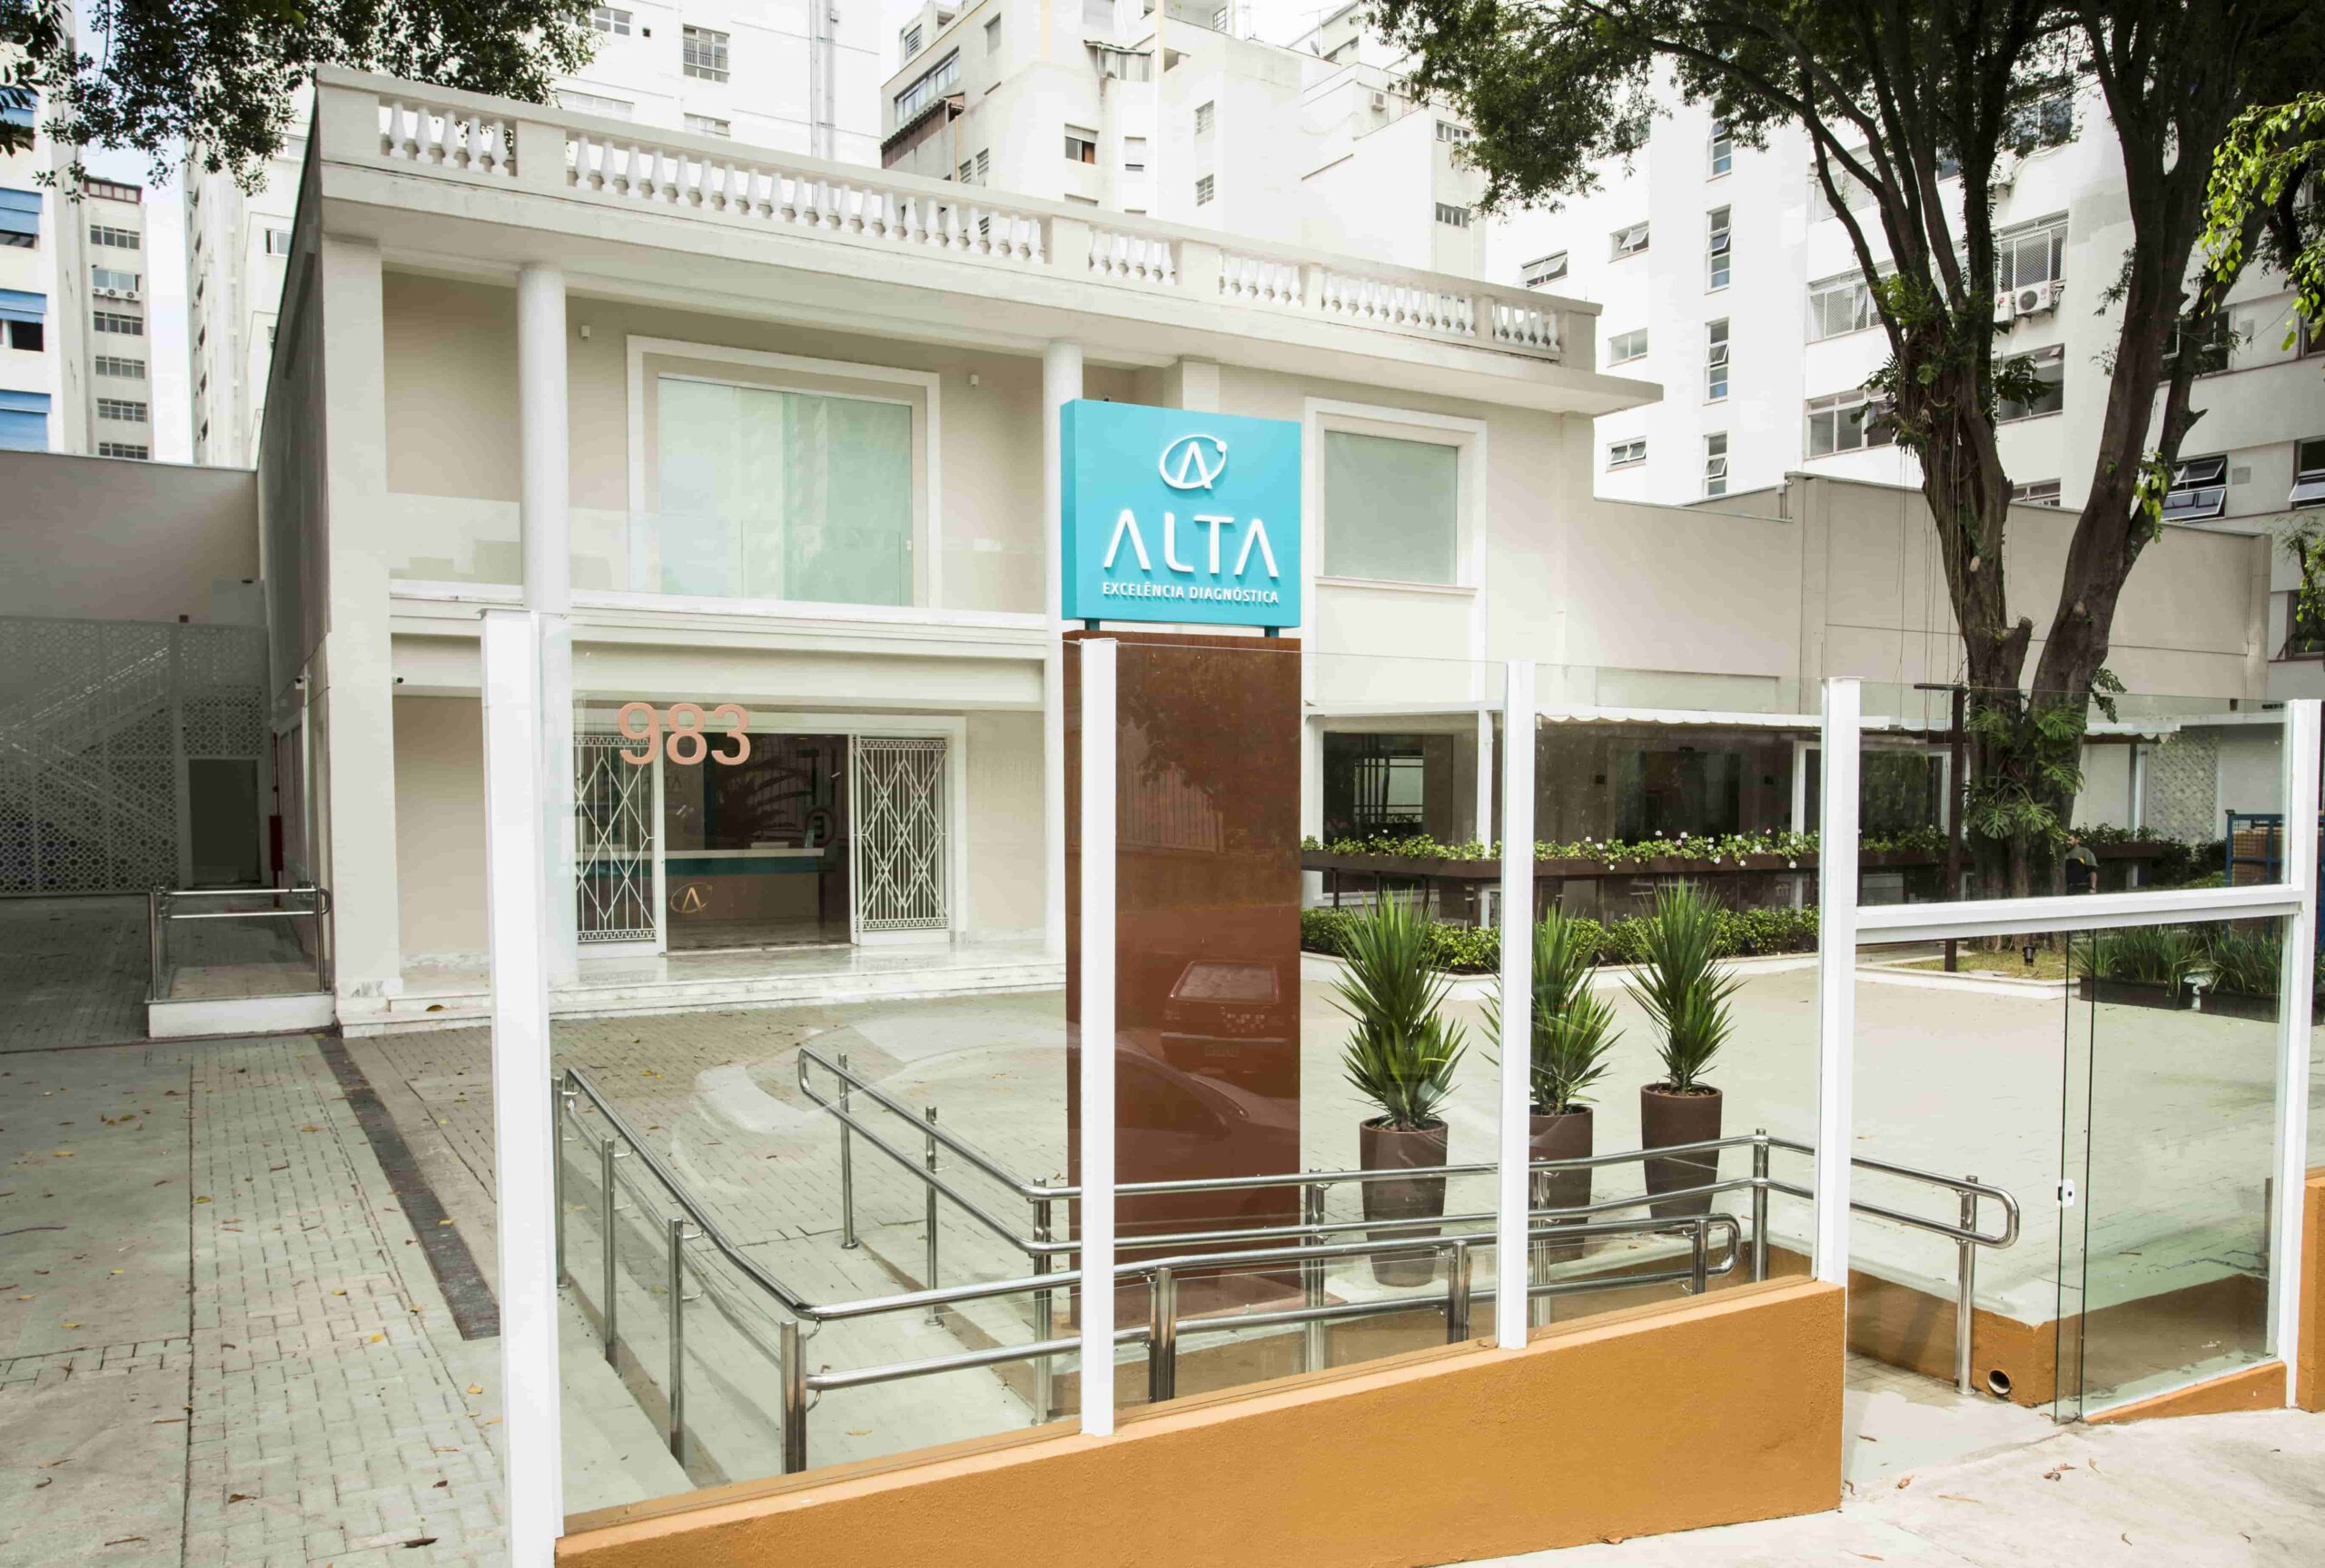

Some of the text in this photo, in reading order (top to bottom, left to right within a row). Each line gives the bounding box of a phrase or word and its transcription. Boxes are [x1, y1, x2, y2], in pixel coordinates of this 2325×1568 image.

[1103, 508, 1279, 577] ALTA
[1103, 581, 1279, 603] EXCELÊNCIA DIAGNÓSTICA
[618, 702, 751, 765] 983
